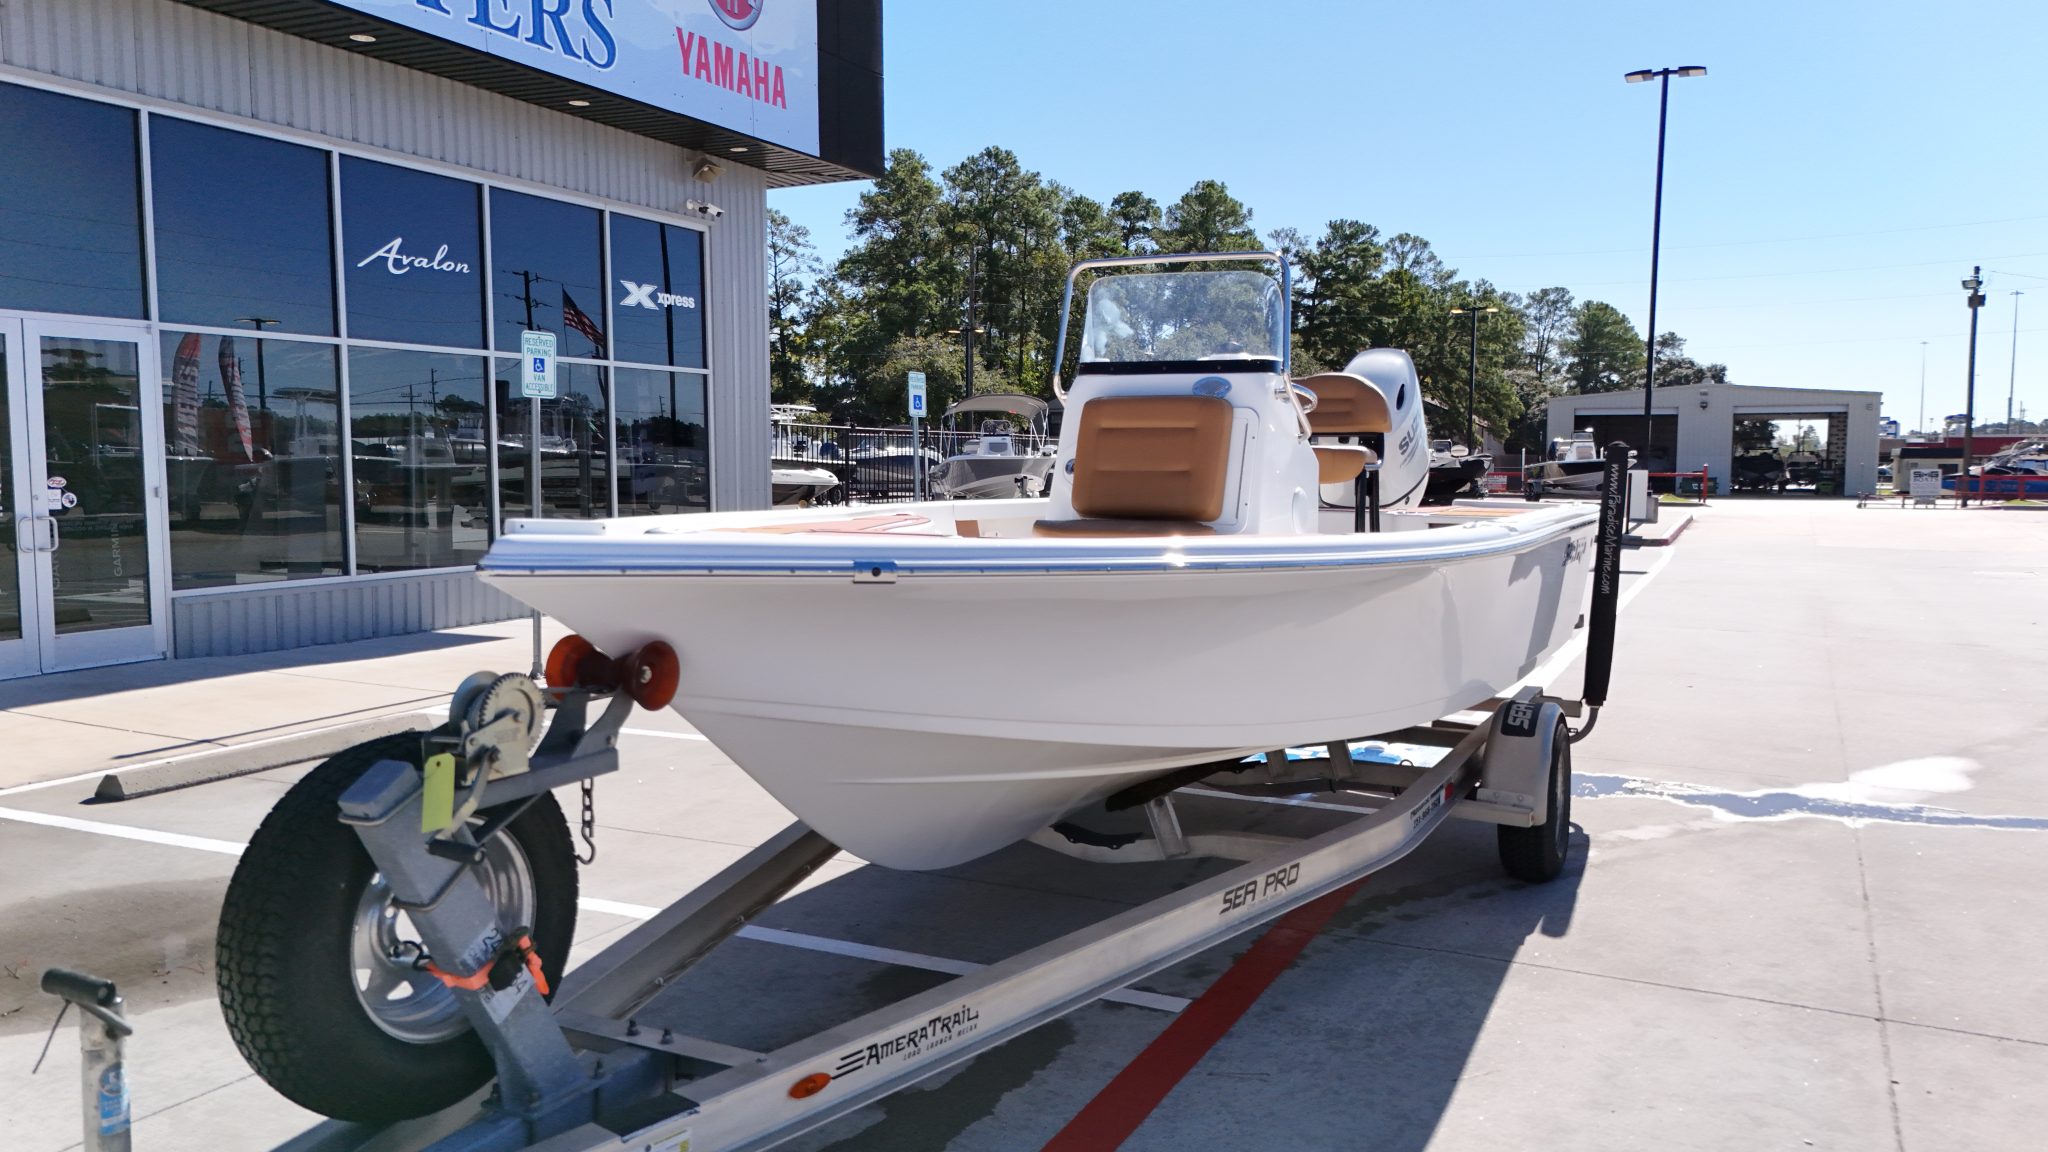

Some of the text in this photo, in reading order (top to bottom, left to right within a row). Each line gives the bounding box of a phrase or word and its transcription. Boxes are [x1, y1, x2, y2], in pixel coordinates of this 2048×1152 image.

[676, 26, 787, 110] YAMAHA
[357, 237, 471, 275] Avalon
[657, 292, 695, 309] xpress
[525, 337, 553, 348] RESERVED
[526, 347, 552, 357] PARKING
[525, 383, 553, 392] ACCESSIBLE
[533, 373, 546, 382] VAN
[1601, 464, 1621, 594] www.ParadiseMarine.com
[111, 523, 123, 577] GARMIN
[1219, 862, 1300, 915] SEA PRO
